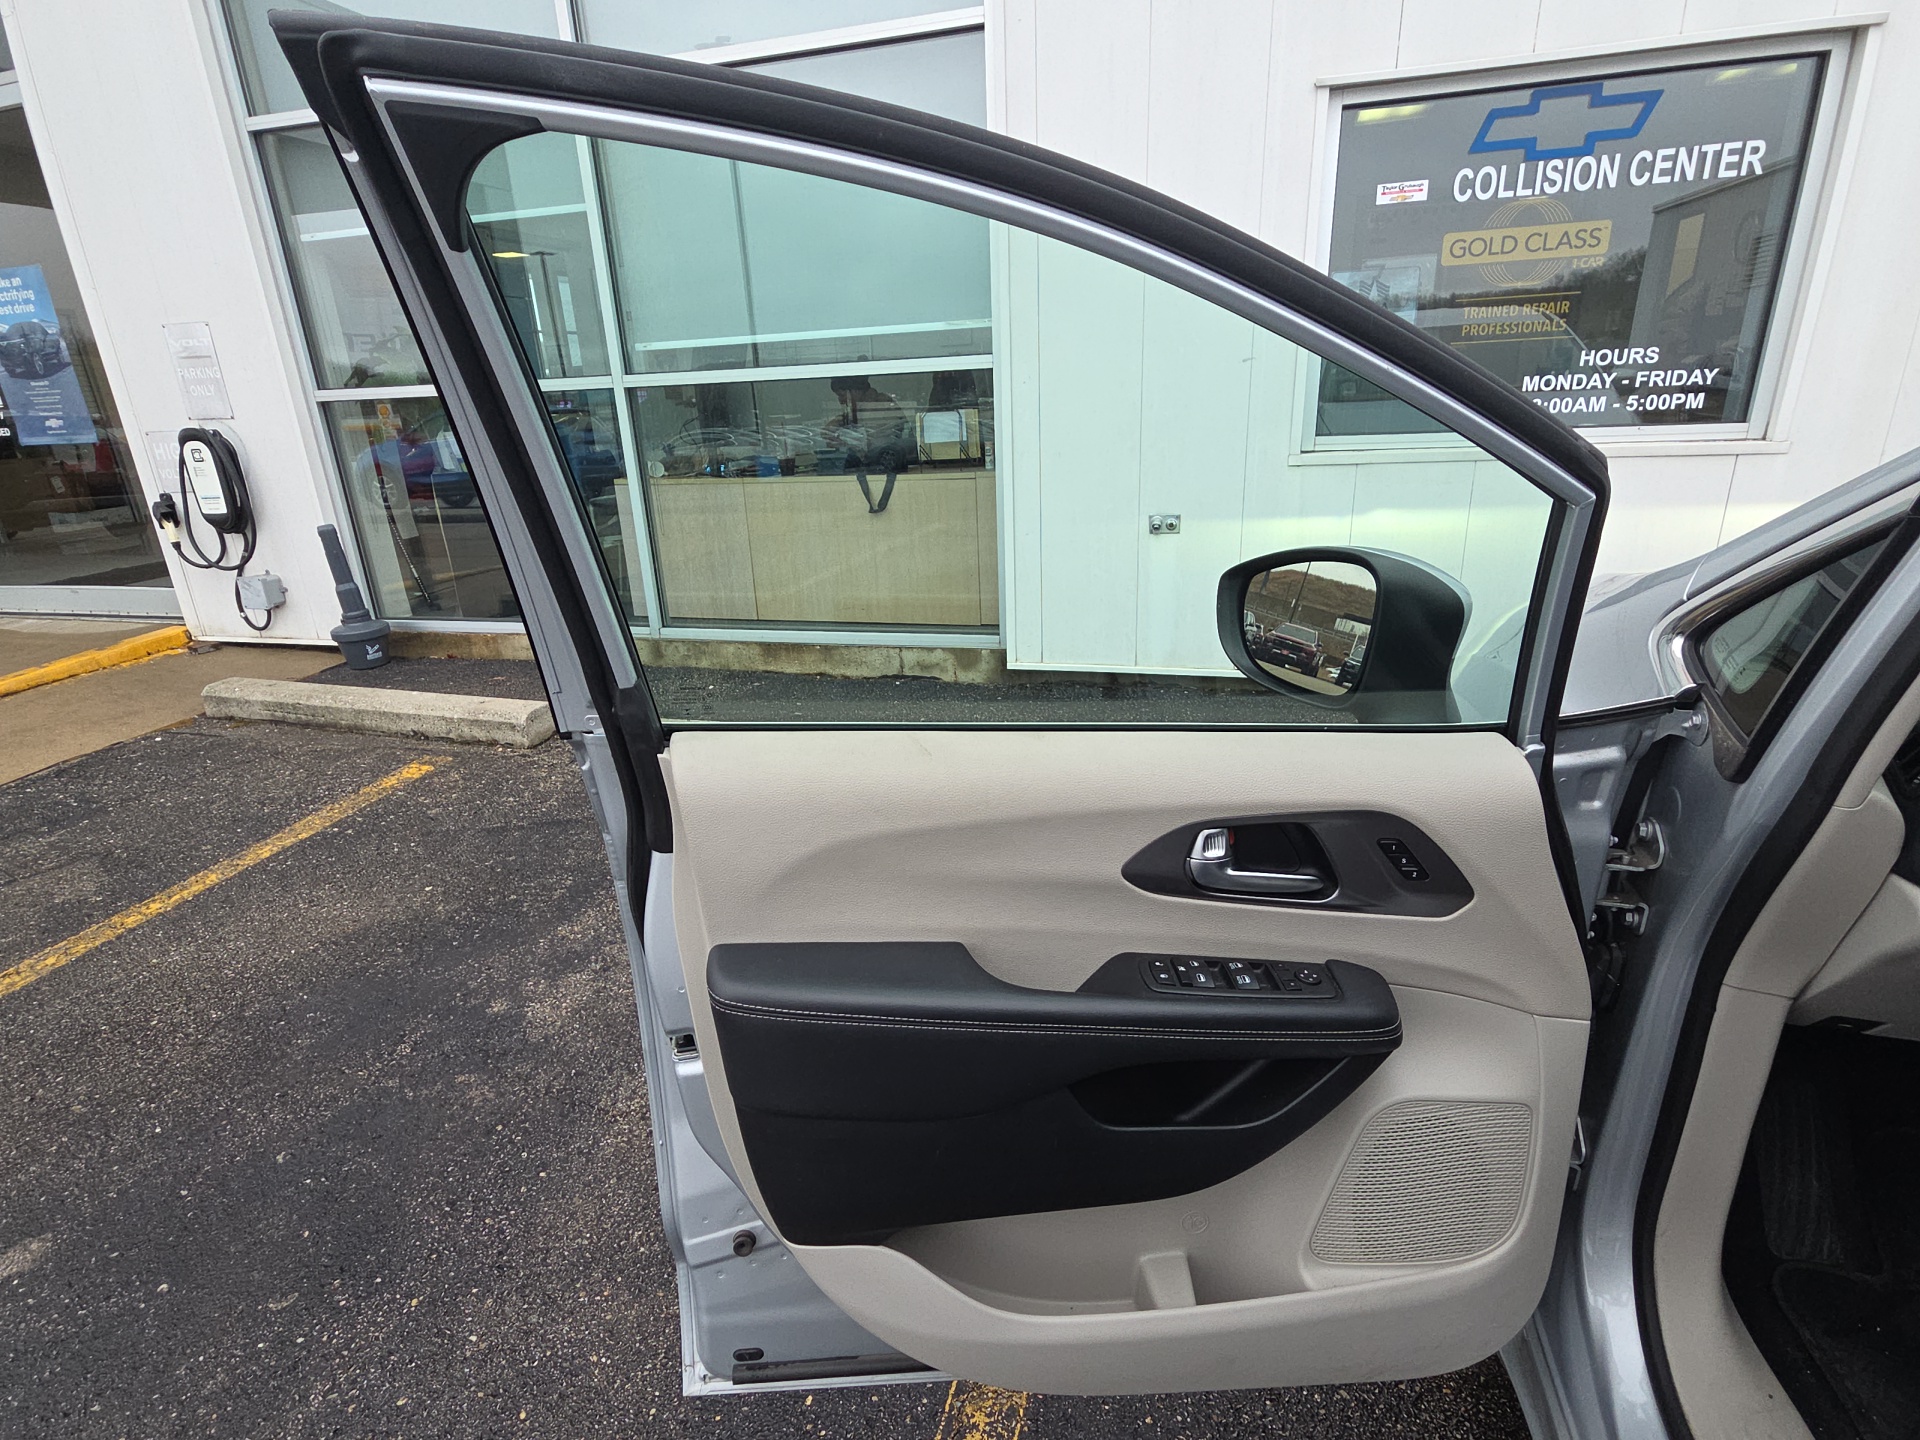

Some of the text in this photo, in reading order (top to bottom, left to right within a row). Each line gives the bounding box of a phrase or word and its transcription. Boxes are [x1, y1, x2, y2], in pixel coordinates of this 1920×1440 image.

[1453, 139, 1767, 203] COLLISION CENTER
[1449, 227, 1603, 259] GOLD CLASS
[0, 288, 36, 302] ctrifying
[0, 302, 36, 315] est drive
[1463, 300, 1570, 319] TRAINED REPAIR
[1461, 318, 1568, 337] PROFESSIONALS
[1579, 346, 1660, 367] HOURS
[177, 366, 221, 380] PARKING
[1522, 372, 1617, 392] MONDAY
[1634, 368, 1720, 388] FRIDAY
[189, 383, 216, 396] ONLY
[1625, 392, 1706, 412] 5:00PM
[152, 442, 181, 460] HIG
